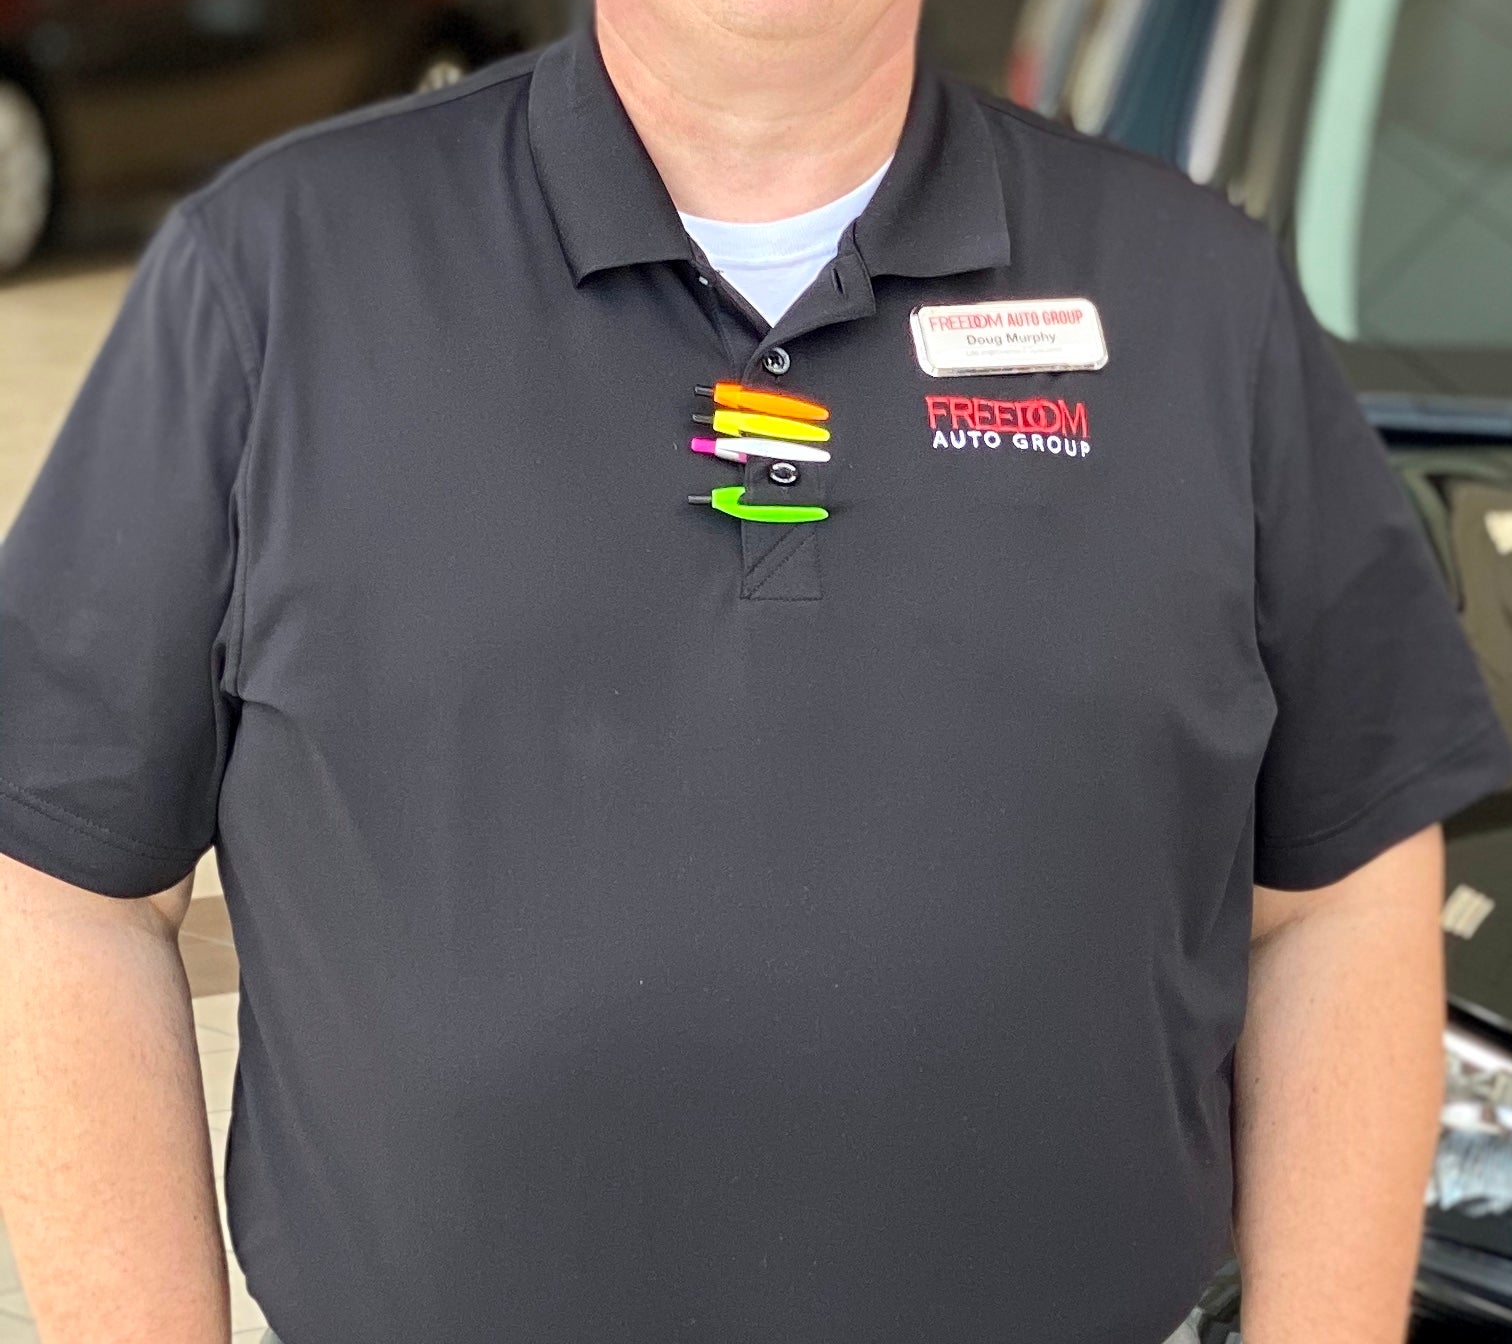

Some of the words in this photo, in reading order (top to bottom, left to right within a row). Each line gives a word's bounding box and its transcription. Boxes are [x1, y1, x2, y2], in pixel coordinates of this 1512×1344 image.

[929, 314, 1003, 331] FREEDOM
[1007, 310, 1039, 327] AUTO
[1043, 309, 1084, 325] GROUP
[966, 334, 1003, 346] Doug
[1006, 331, 1056, 344] Murphy
[926, 396, 1089, 438] FREEDOM
[933, 430, 1001, 449] AUTO
[1012, 433, 1091, 457] GROUP
